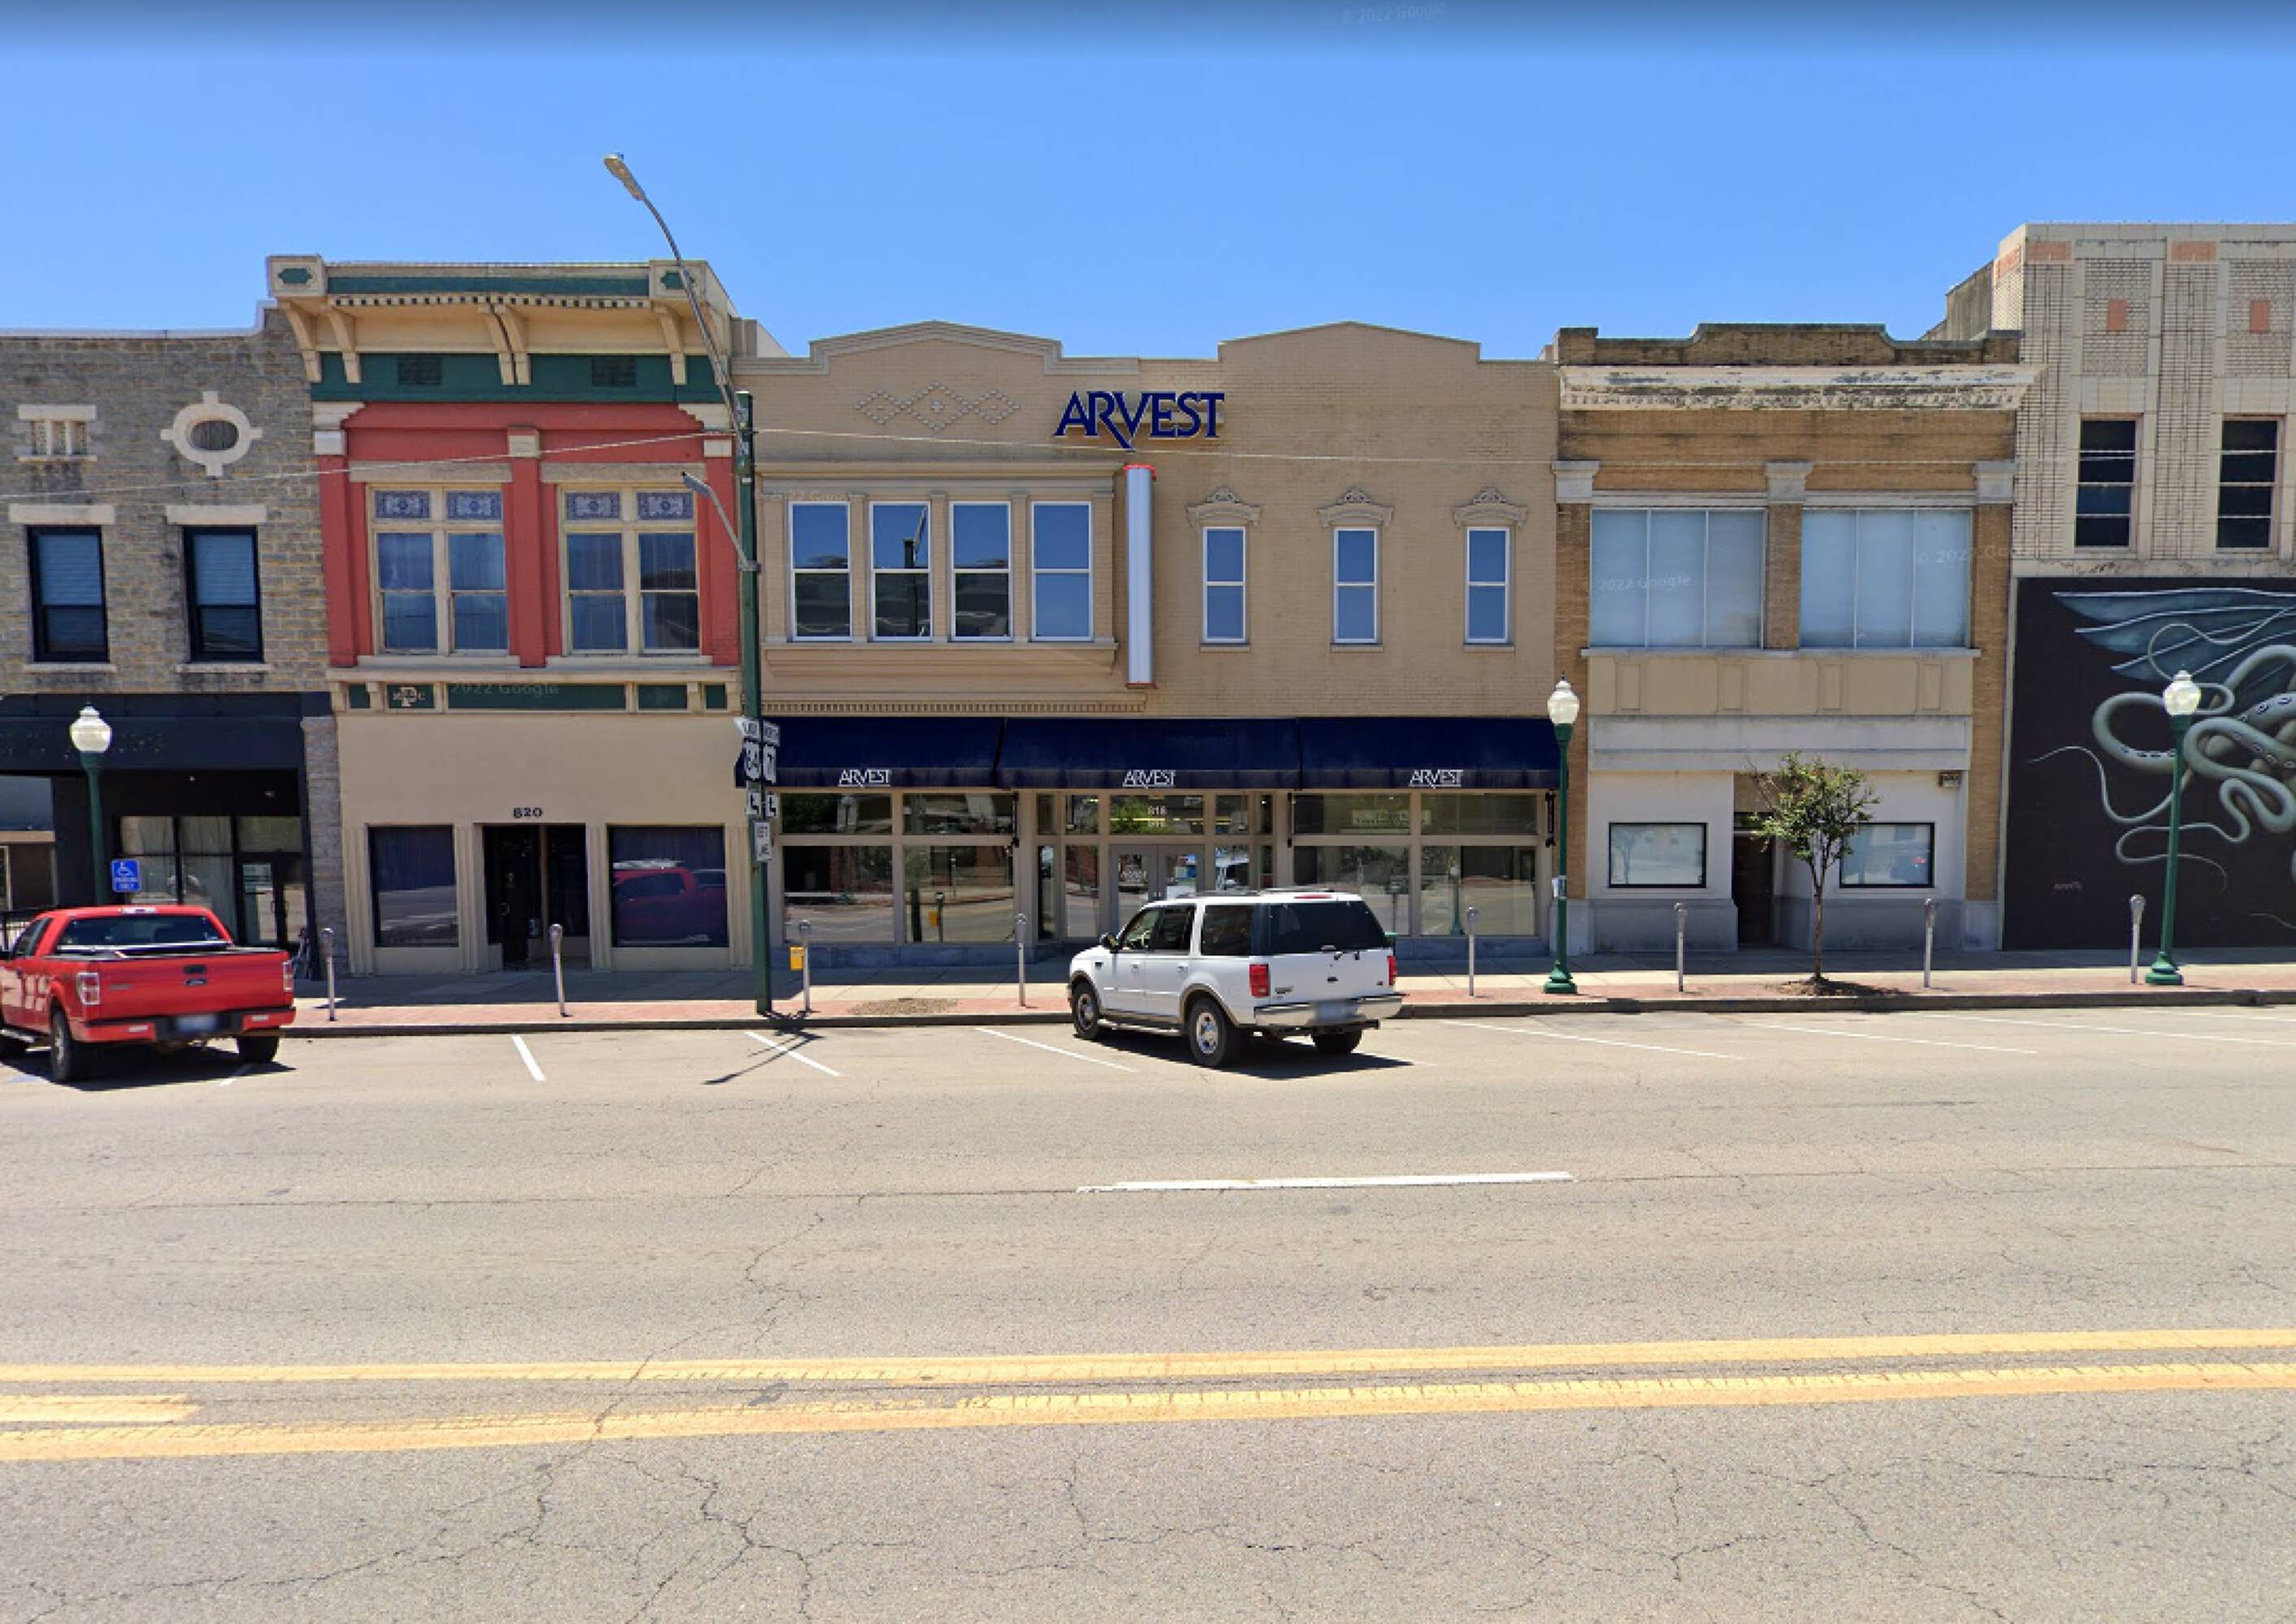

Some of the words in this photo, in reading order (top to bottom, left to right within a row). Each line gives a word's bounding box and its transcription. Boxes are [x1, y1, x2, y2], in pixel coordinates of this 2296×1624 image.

[1053, 391, 1225, 452] ARVEST
[839, 769, 890, 788] ARVEST
[1123, 769, 1176, 788] ARVEST
[1409, 769, 1463, 788] ARVEST
[513, 807, 542, 818] 820
